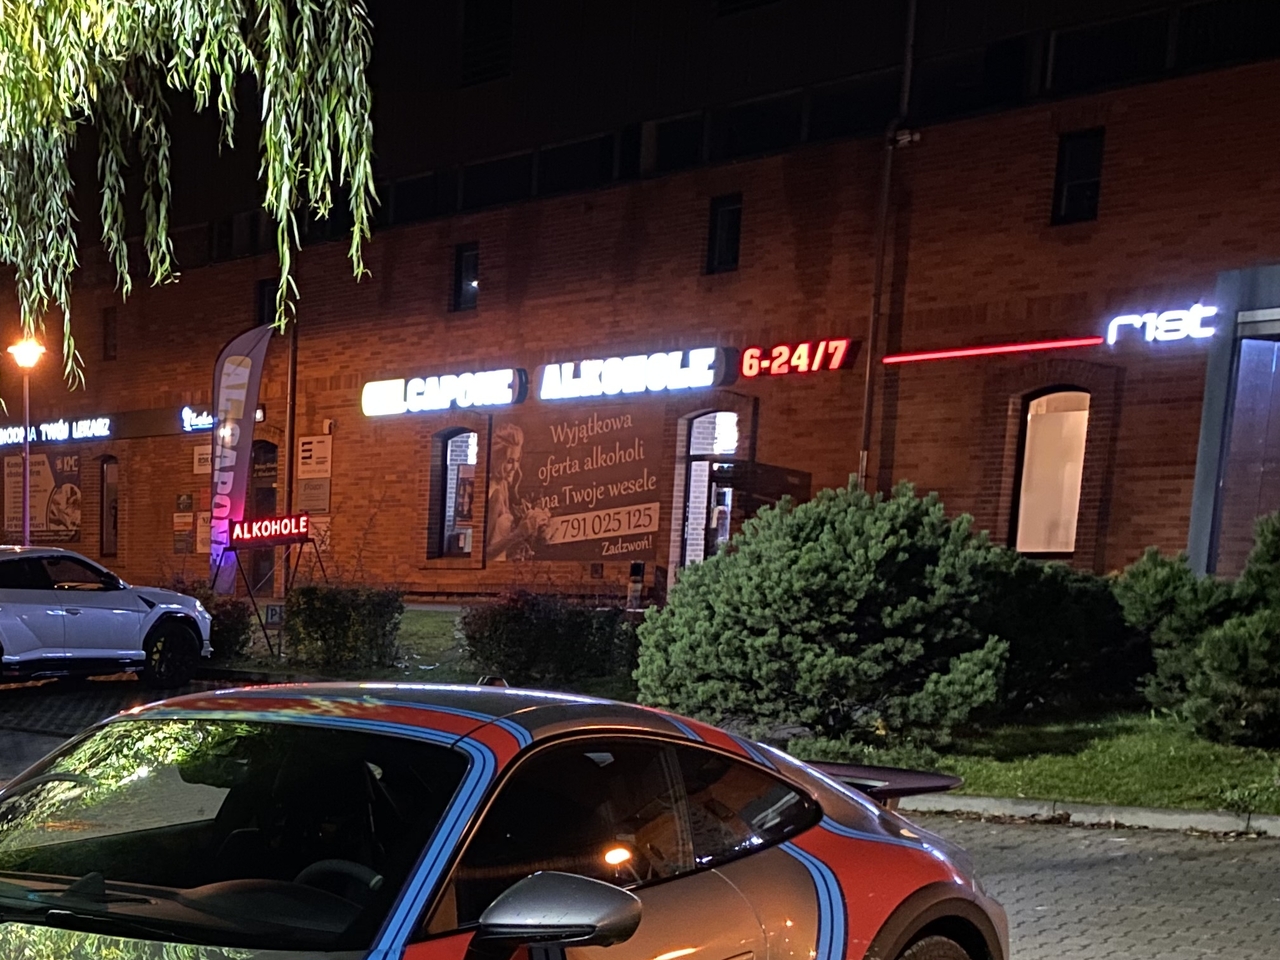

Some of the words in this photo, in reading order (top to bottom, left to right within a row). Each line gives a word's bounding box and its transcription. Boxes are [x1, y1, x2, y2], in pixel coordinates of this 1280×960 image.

[539, 347, 717, 400] ALKOHOLE
[742, 339, 849, 377] 6-24/7
[72, 418, 110, 438] LEKARZ
[549, 412, 633, 448] Wyjątkowa
[538, 455, 580, 486] oferta
[584, 437, 645, 471] alkoholi
[541, 494, 559, 509] na
[562, 482, 605, 508] Twoje
[608, 468, 657, 497] wesele
[233, 516, 308, 540] ALKOHOLE
[560, 517, 588, 540] 791
[591, 512, 622, 536] 025
[625, 507, 653, 530] 125
[601, 534, 653, 556] Zadzwoń!
